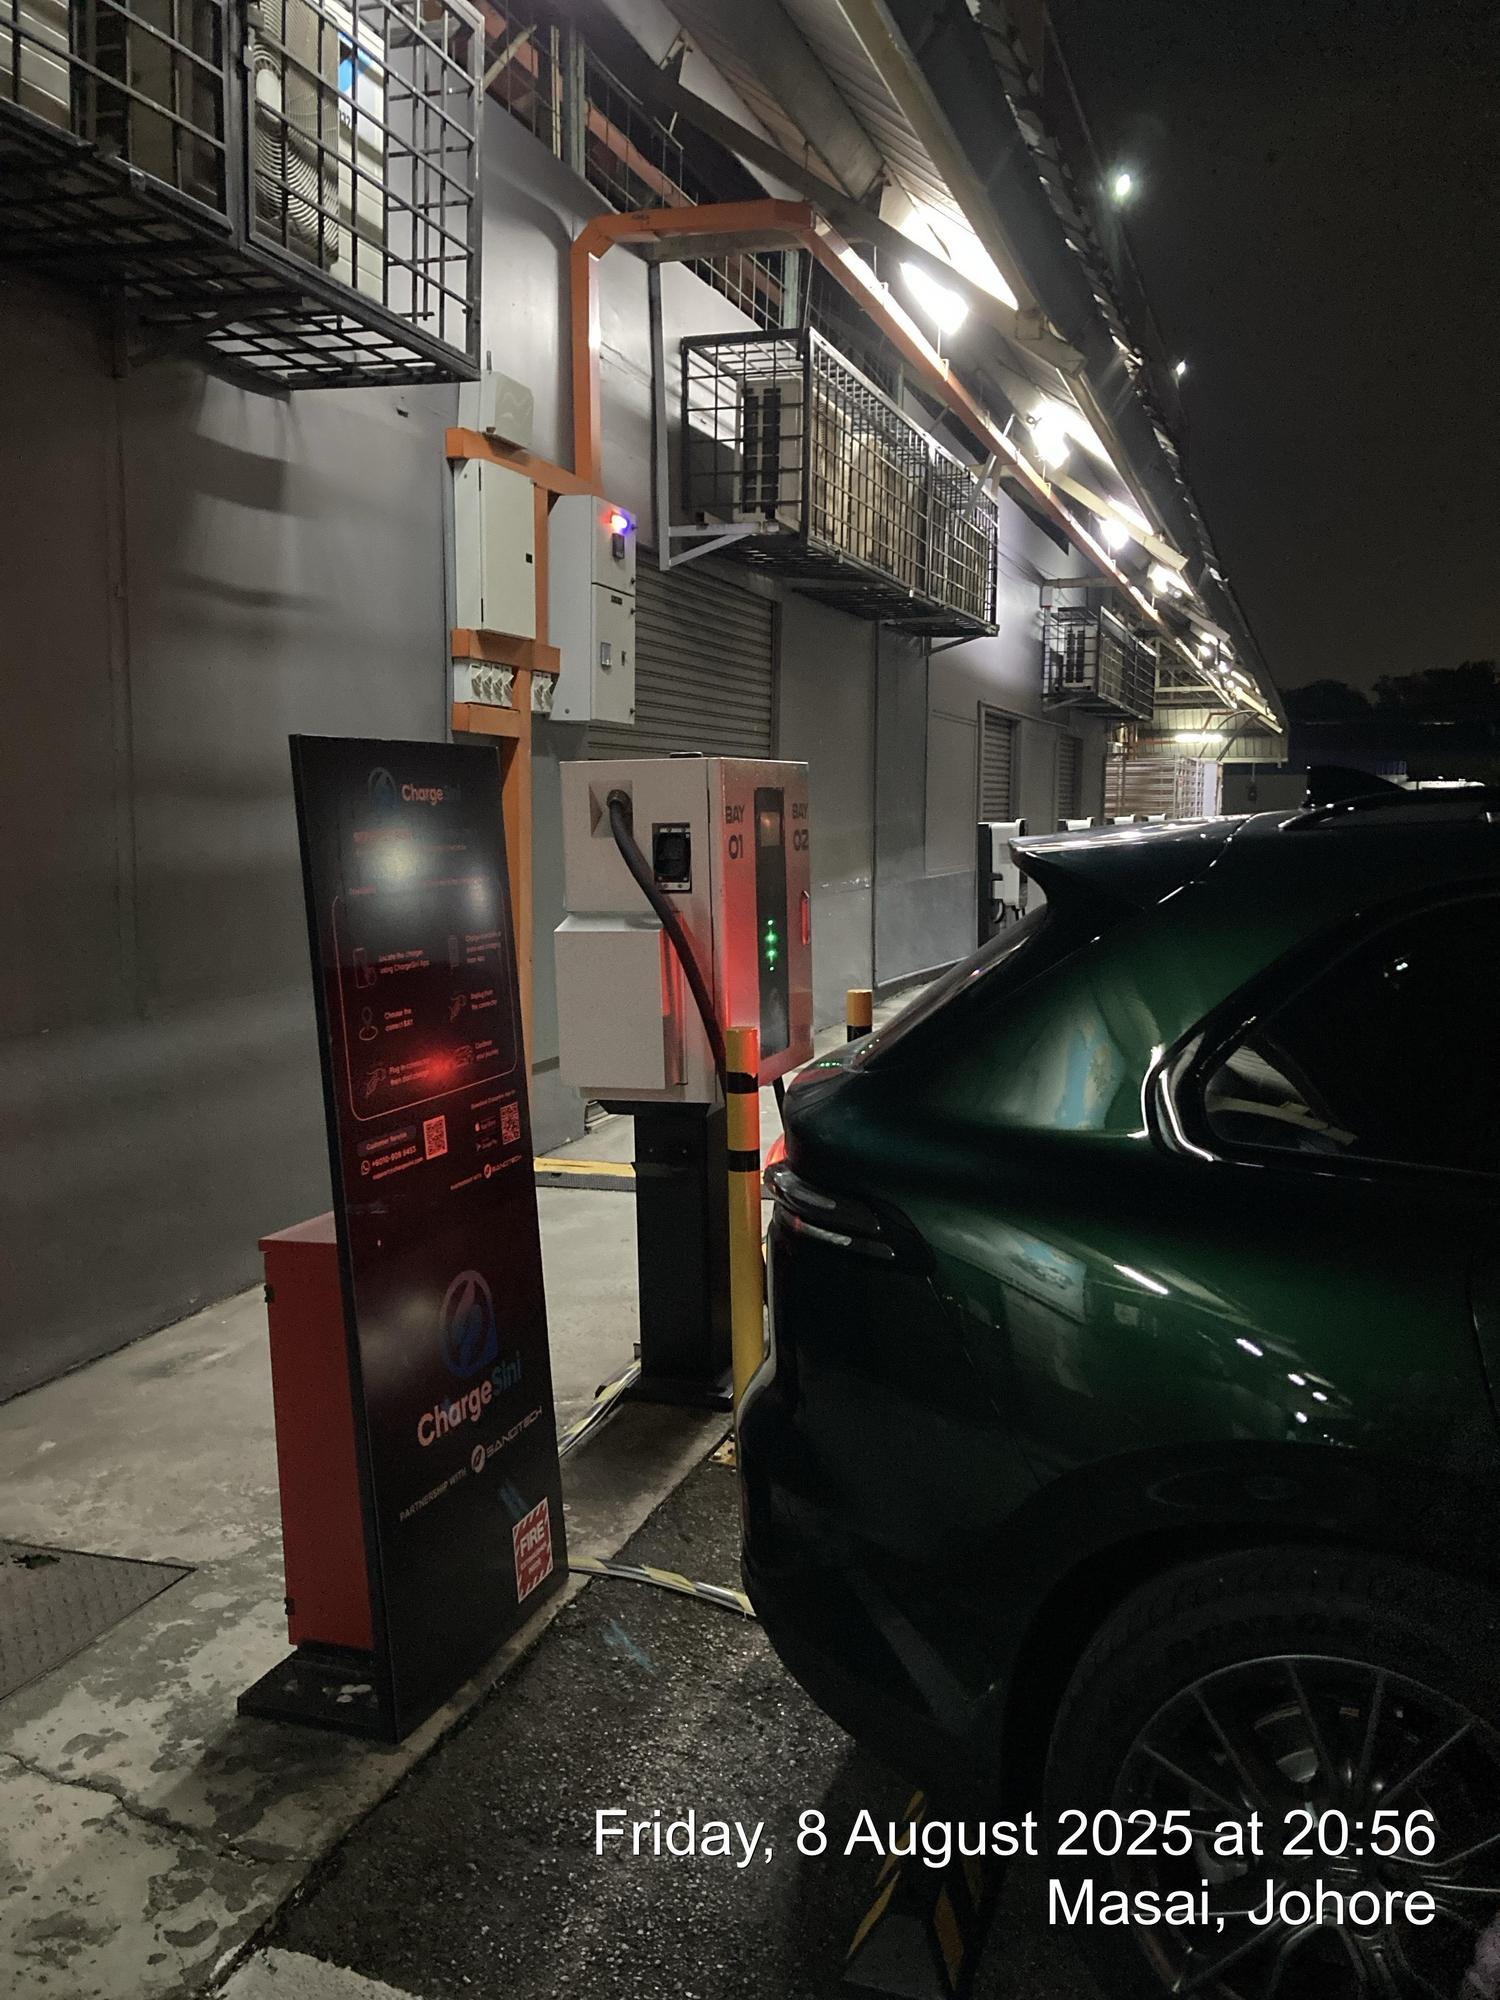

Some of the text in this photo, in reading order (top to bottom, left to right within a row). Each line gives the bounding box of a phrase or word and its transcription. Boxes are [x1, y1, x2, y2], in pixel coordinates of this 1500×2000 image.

[725, 804, 746, 824] BAY
[792, 802, 809, 820] BAY
[728, 834, 744, 859] 01
[792, 829, 809, 852] 02
[417, 1350, 522, 1447] ChargeSini
[519, 1519, 546, 1558] FIRE
